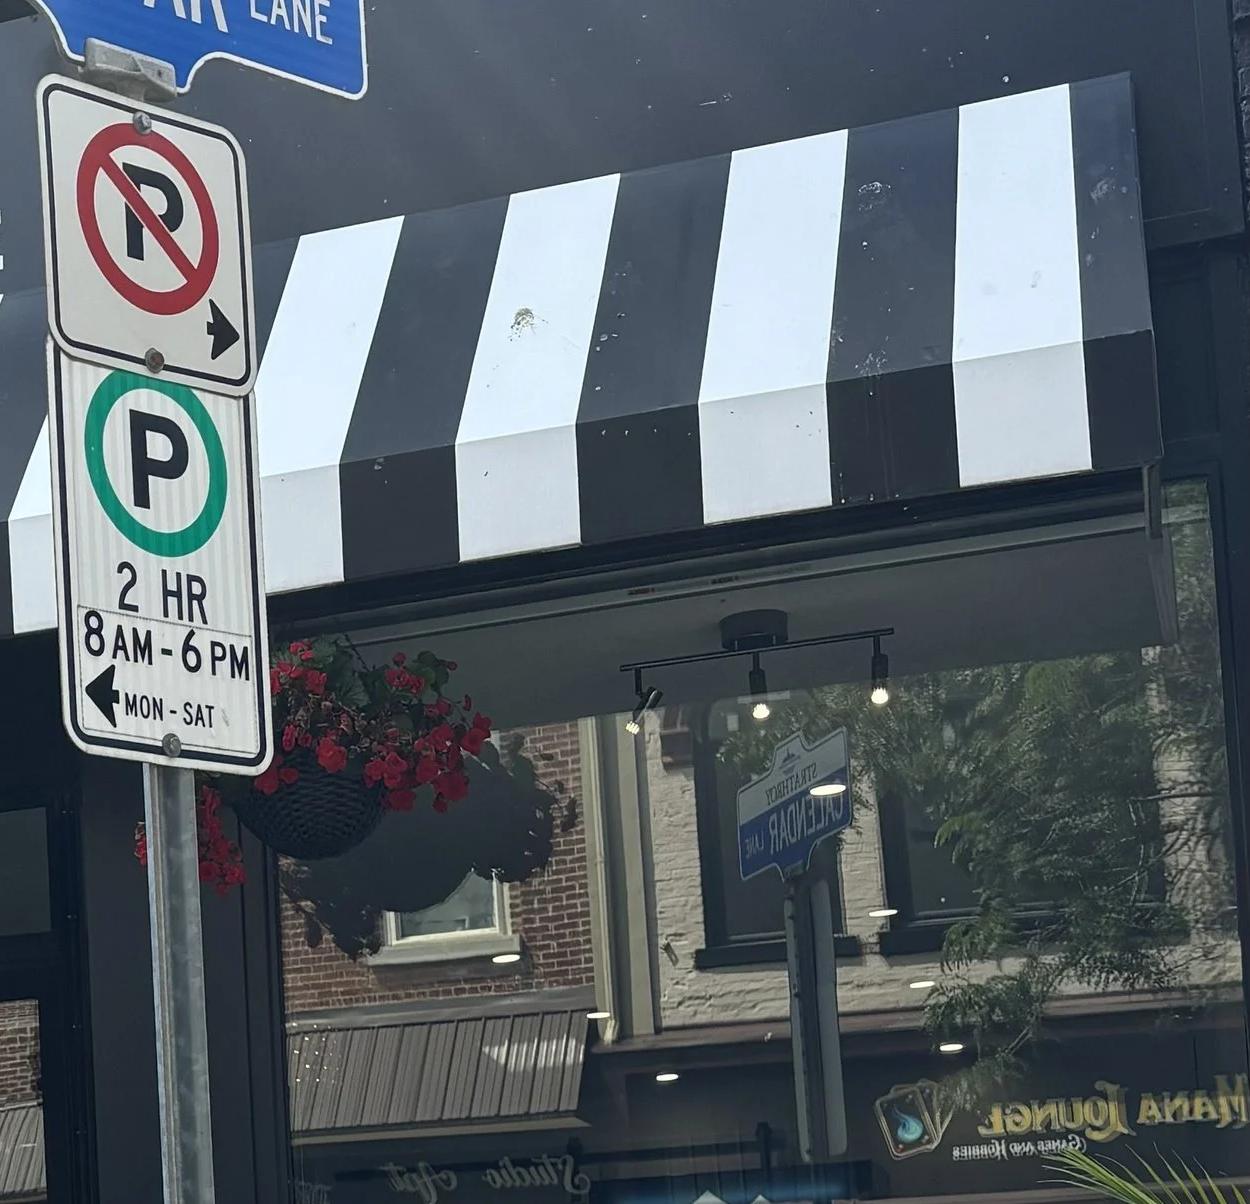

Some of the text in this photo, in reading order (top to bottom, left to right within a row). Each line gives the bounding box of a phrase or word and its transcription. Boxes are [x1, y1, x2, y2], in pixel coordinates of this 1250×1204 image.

[129, 409, 189, 509] P
[117, 561, 208, 625] 2 HR
